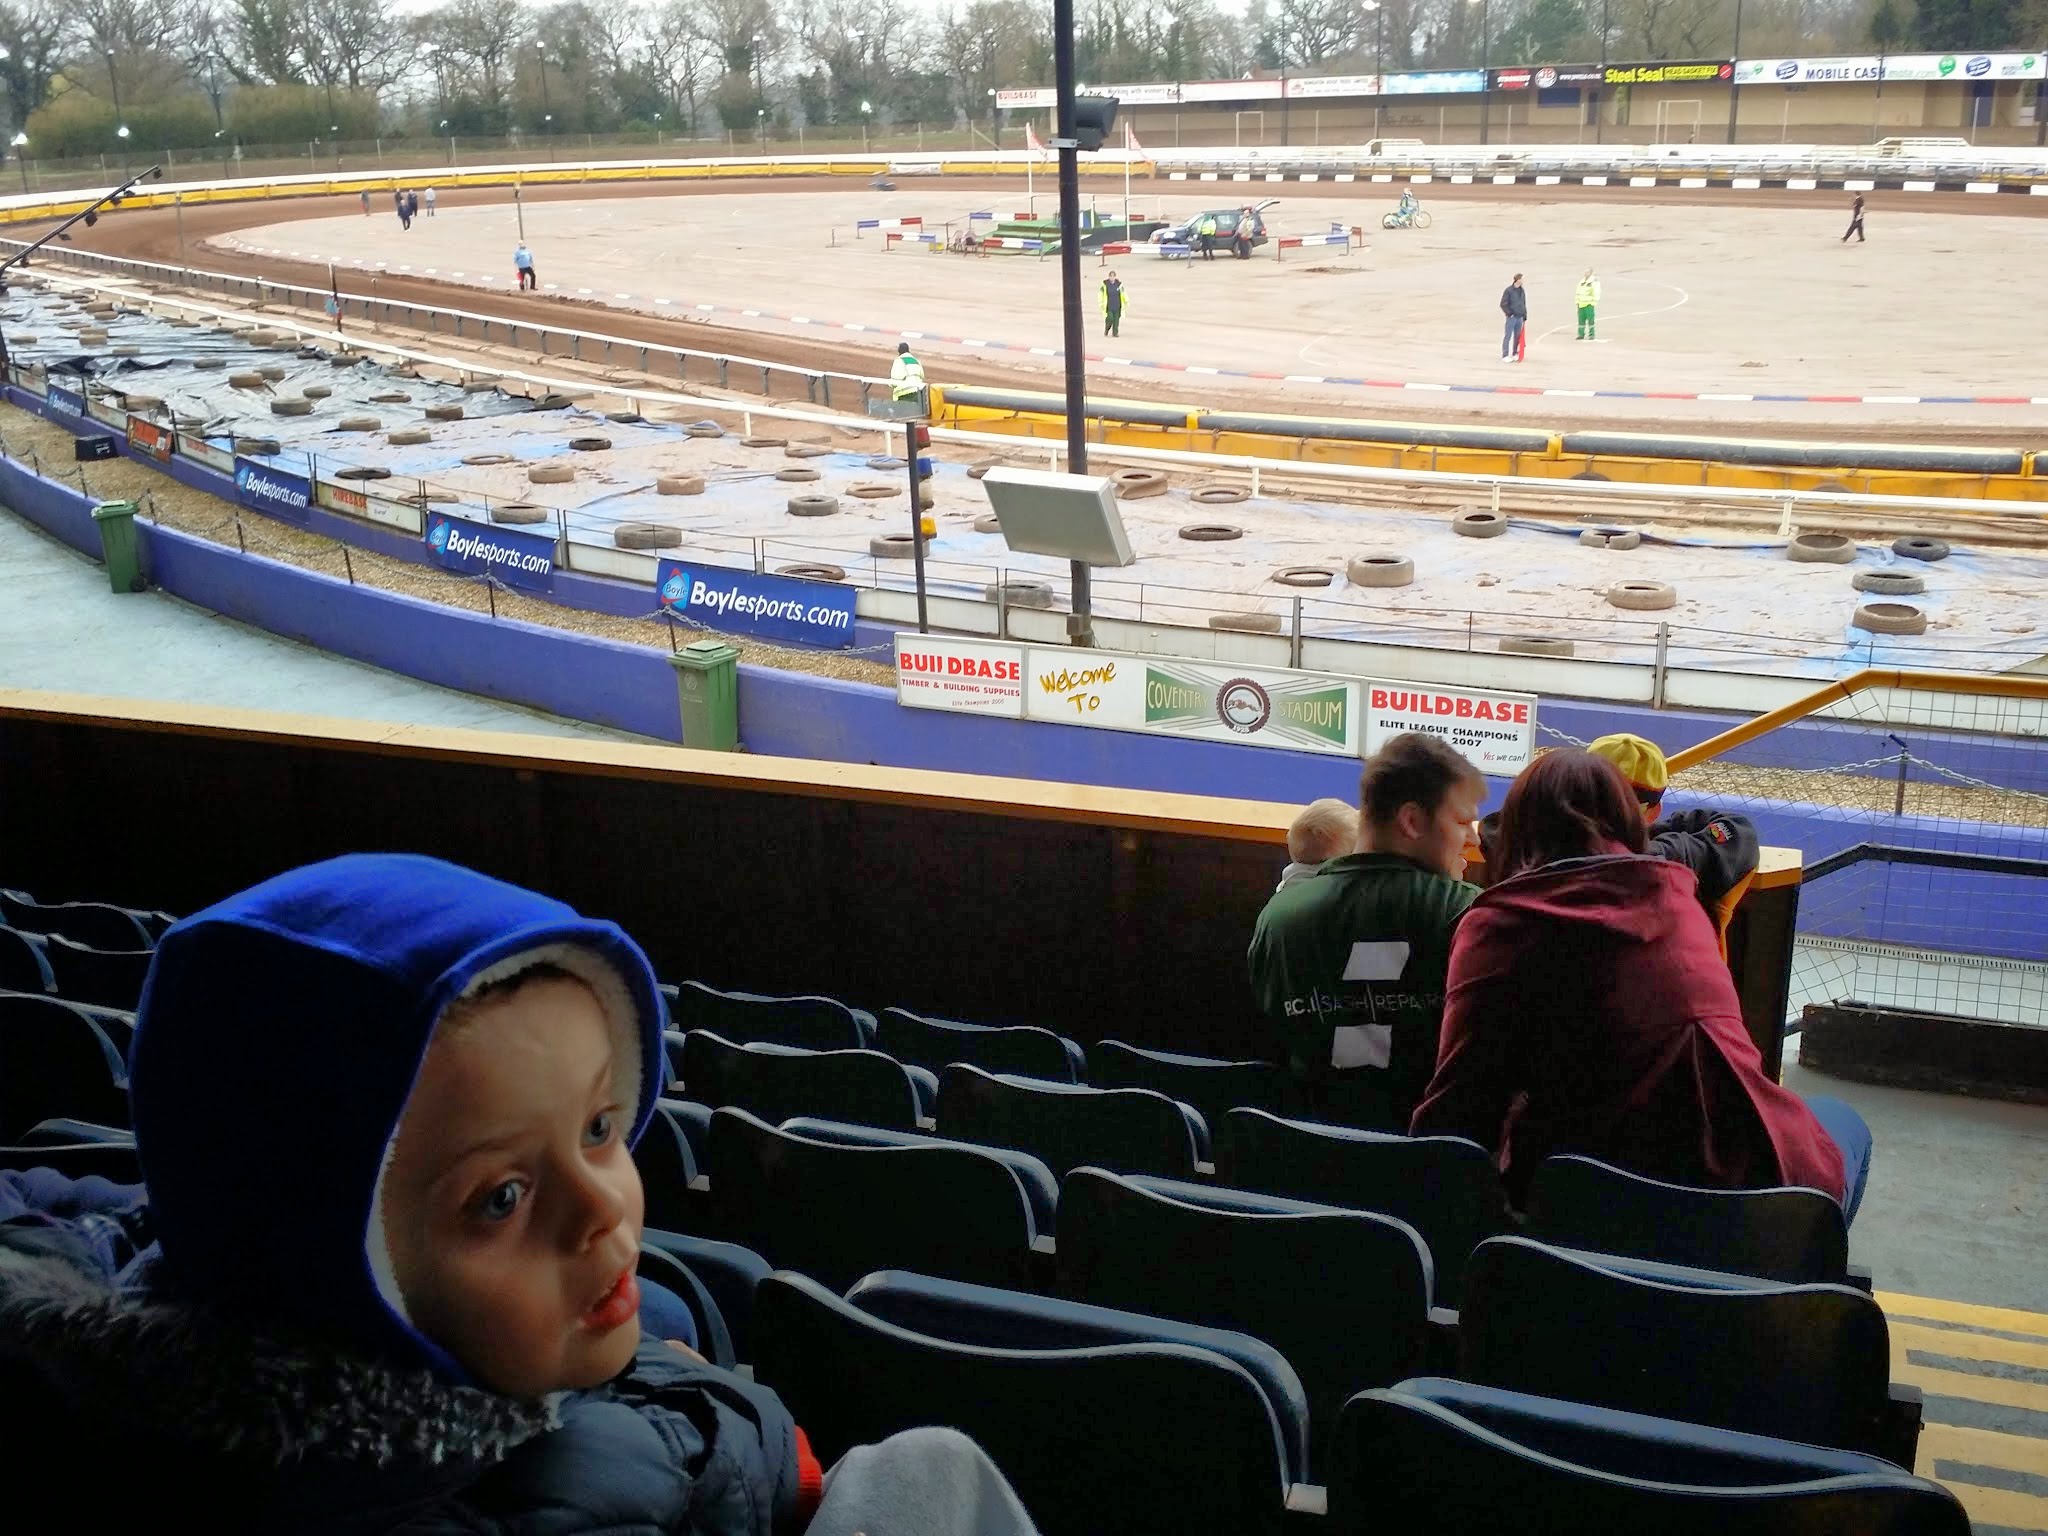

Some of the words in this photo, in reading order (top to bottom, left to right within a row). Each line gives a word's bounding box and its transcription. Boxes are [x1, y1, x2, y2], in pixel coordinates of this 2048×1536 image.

[1605, 68, 1636, 83] Steel
[1637, 67, 1665, 82] Seal
[1805, 67, 1850, 80] MOBILE
[1854, 66, 1886, 80] CASH
[246, 472, 307, 508] Boylesports.com
[447, 529, 550, 575] Boylesports.com
[665, 583, 687, 597] Boyle
[690, 580, 849, 629] Boylesports.com
[901, 679, 930, 688] TIMBER
[944, 683, 980, 693] BUILDING
[983, 687, 1020, 697] SUPPLIES
[1039, 661, 1117, 695] Welcome
[1147, 679, 1211, 709] COVENTRY
[1277, 700, 1342, 731] STADIUM
[1372, 689, 1529, 724] BUILDBASE
[1380, 720, 1405, 729] ELITE
[1409, 723, 1449, 734] LEAGUE
[1451, 728, 1519, 742] CHAMPIONS
[1451, 737, 1483, 748] 2007
[1482, 751, 1495, 761] Yes
[1508, 752, 1526, 762] can!
